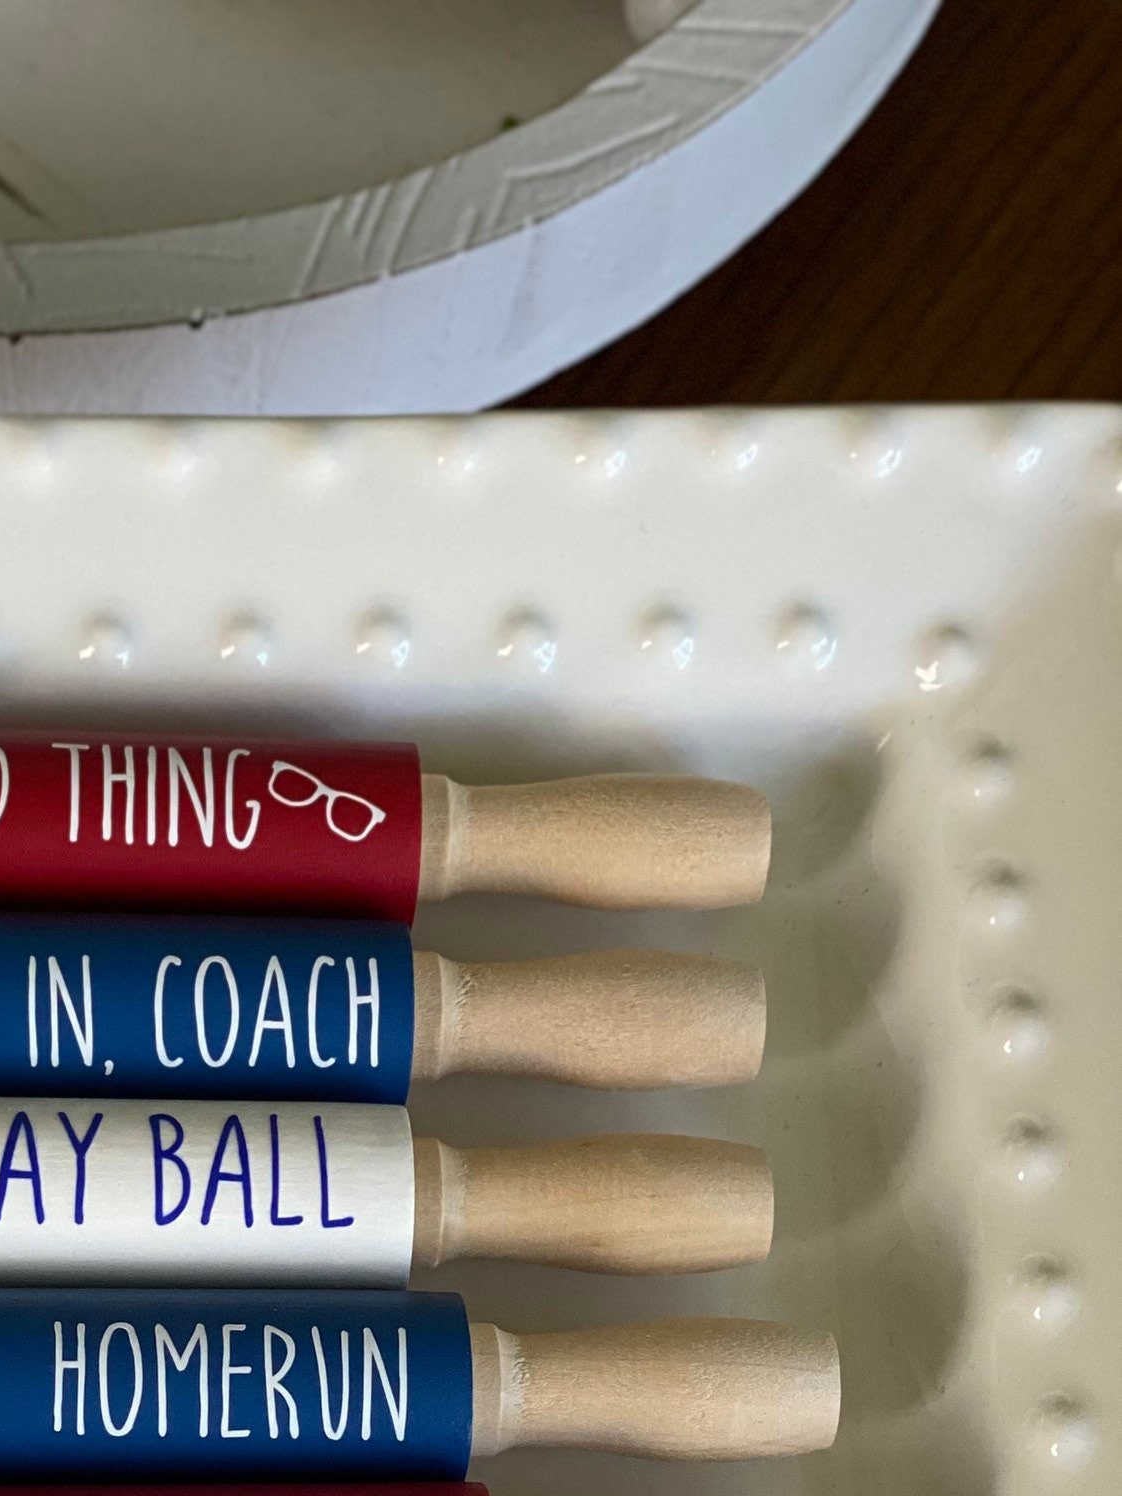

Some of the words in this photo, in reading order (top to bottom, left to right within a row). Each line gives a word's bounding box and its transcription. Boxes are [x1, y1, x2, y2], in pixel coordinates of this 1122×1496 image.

[51, 741, 263, 851] THING
[27, 954, 115, 1077] IN,
[153, 954, 381, 1071] COACH
[148, 1112, 355, 1230] BALL
[51, 1321, 410, 1442] HOMERUN
